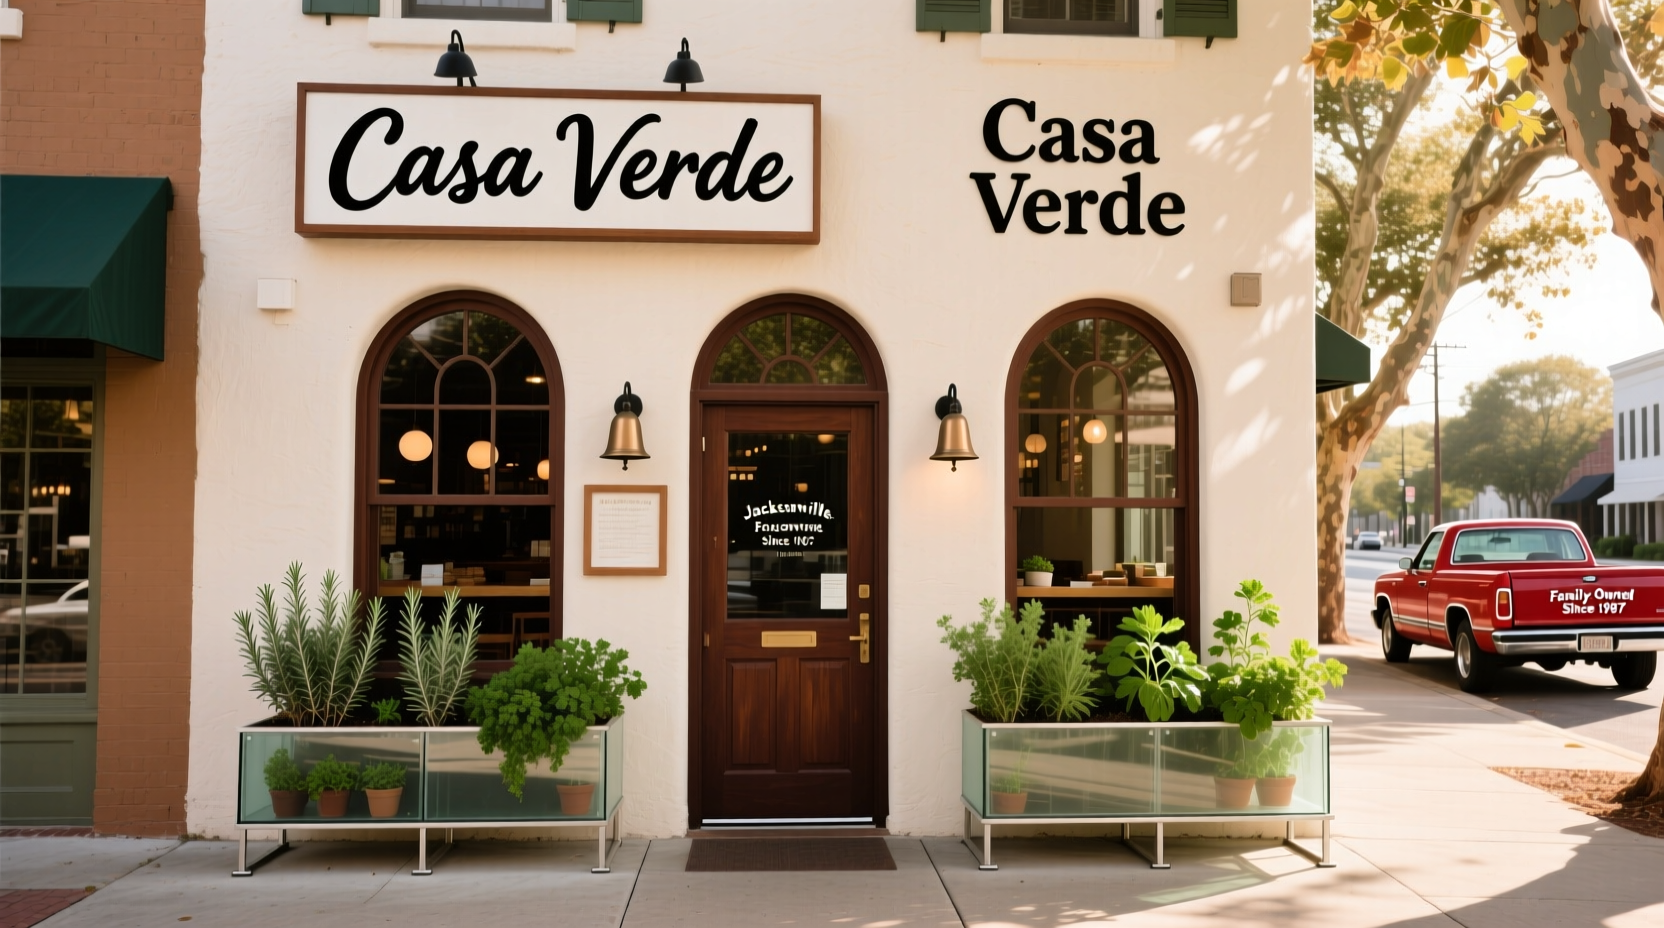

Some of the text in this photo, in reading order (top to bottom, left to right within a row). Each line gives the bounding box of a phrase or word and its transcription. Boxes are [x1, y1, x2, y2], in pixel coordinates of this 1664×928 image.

[328, 107, 794, 212] Casa Verde
[982, 97, 1161, 165] Casa
[969, 171, 1186, 237] Verde
[1549, 588, 1592, 605] Family
[1561, 602, 1595, 615] Since
